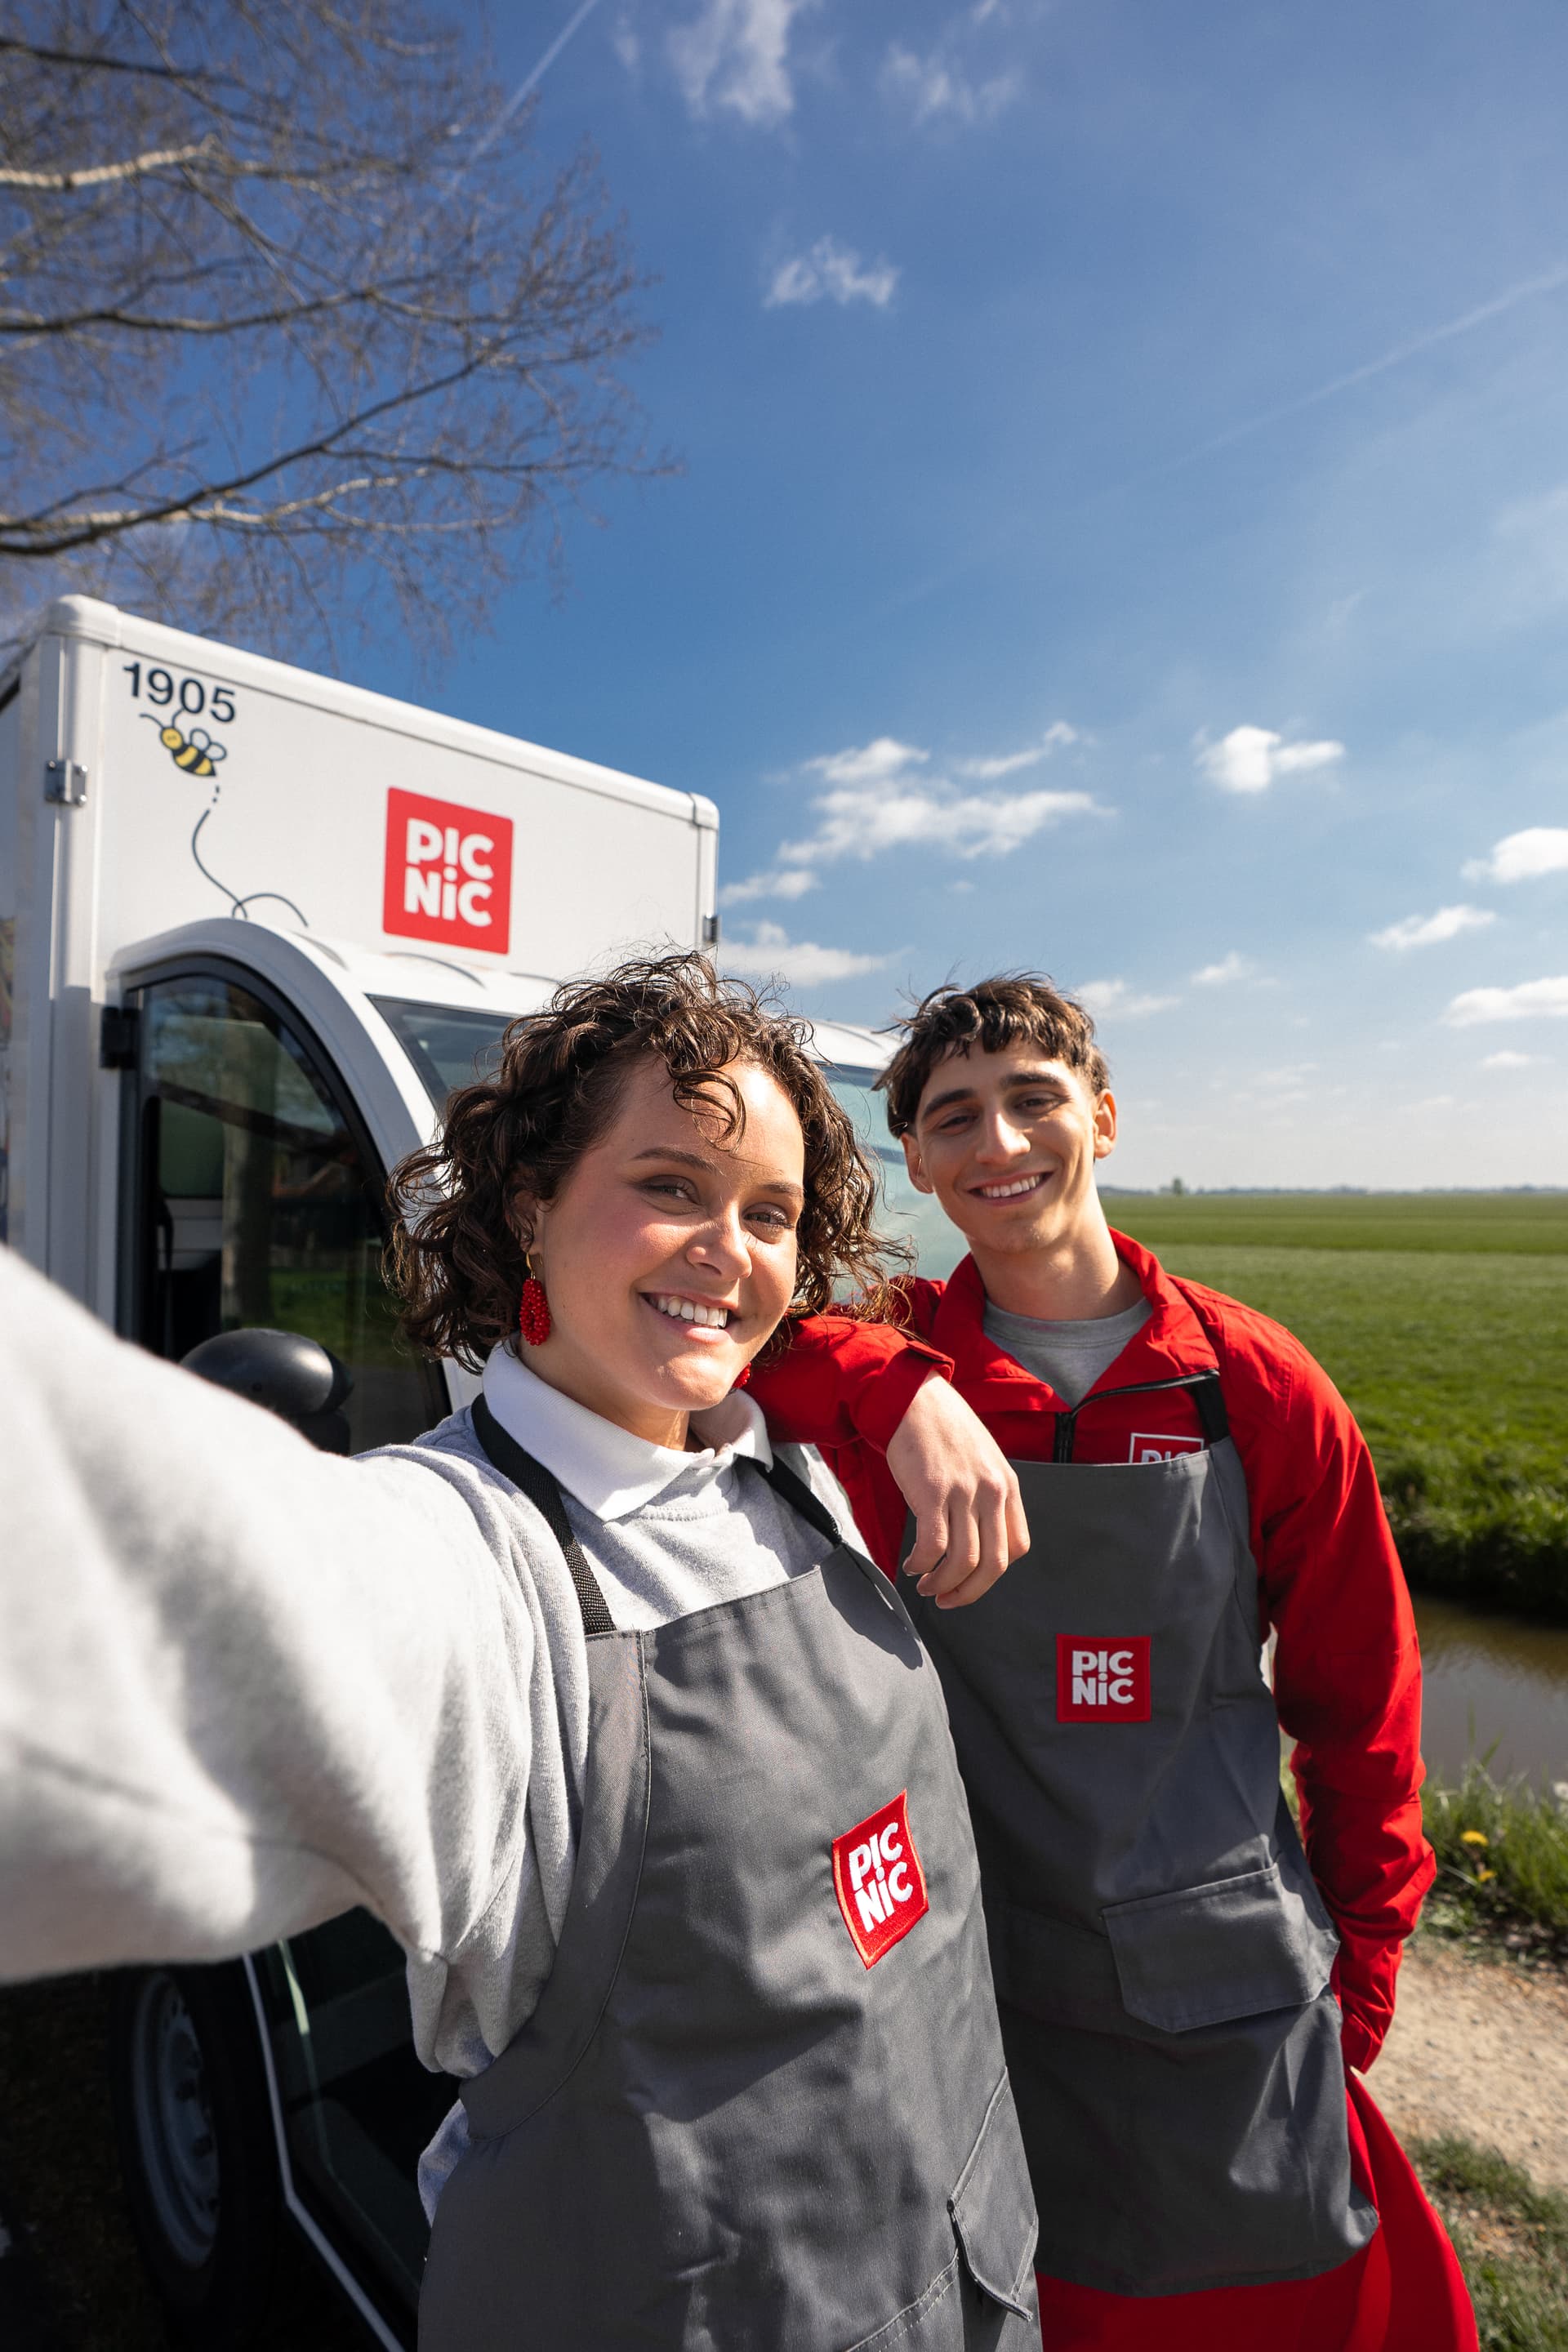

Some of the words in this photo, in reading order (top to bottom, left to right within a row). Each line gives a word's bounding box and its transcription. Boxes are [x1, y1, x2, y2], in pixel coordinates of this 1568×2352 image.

[122, 662, 236, 723] 1905
[406, 817, 494, 880] PIC
[1071, 1650, 1134, 1677] PIC
[849, 1822, 903, 1891] PIC
